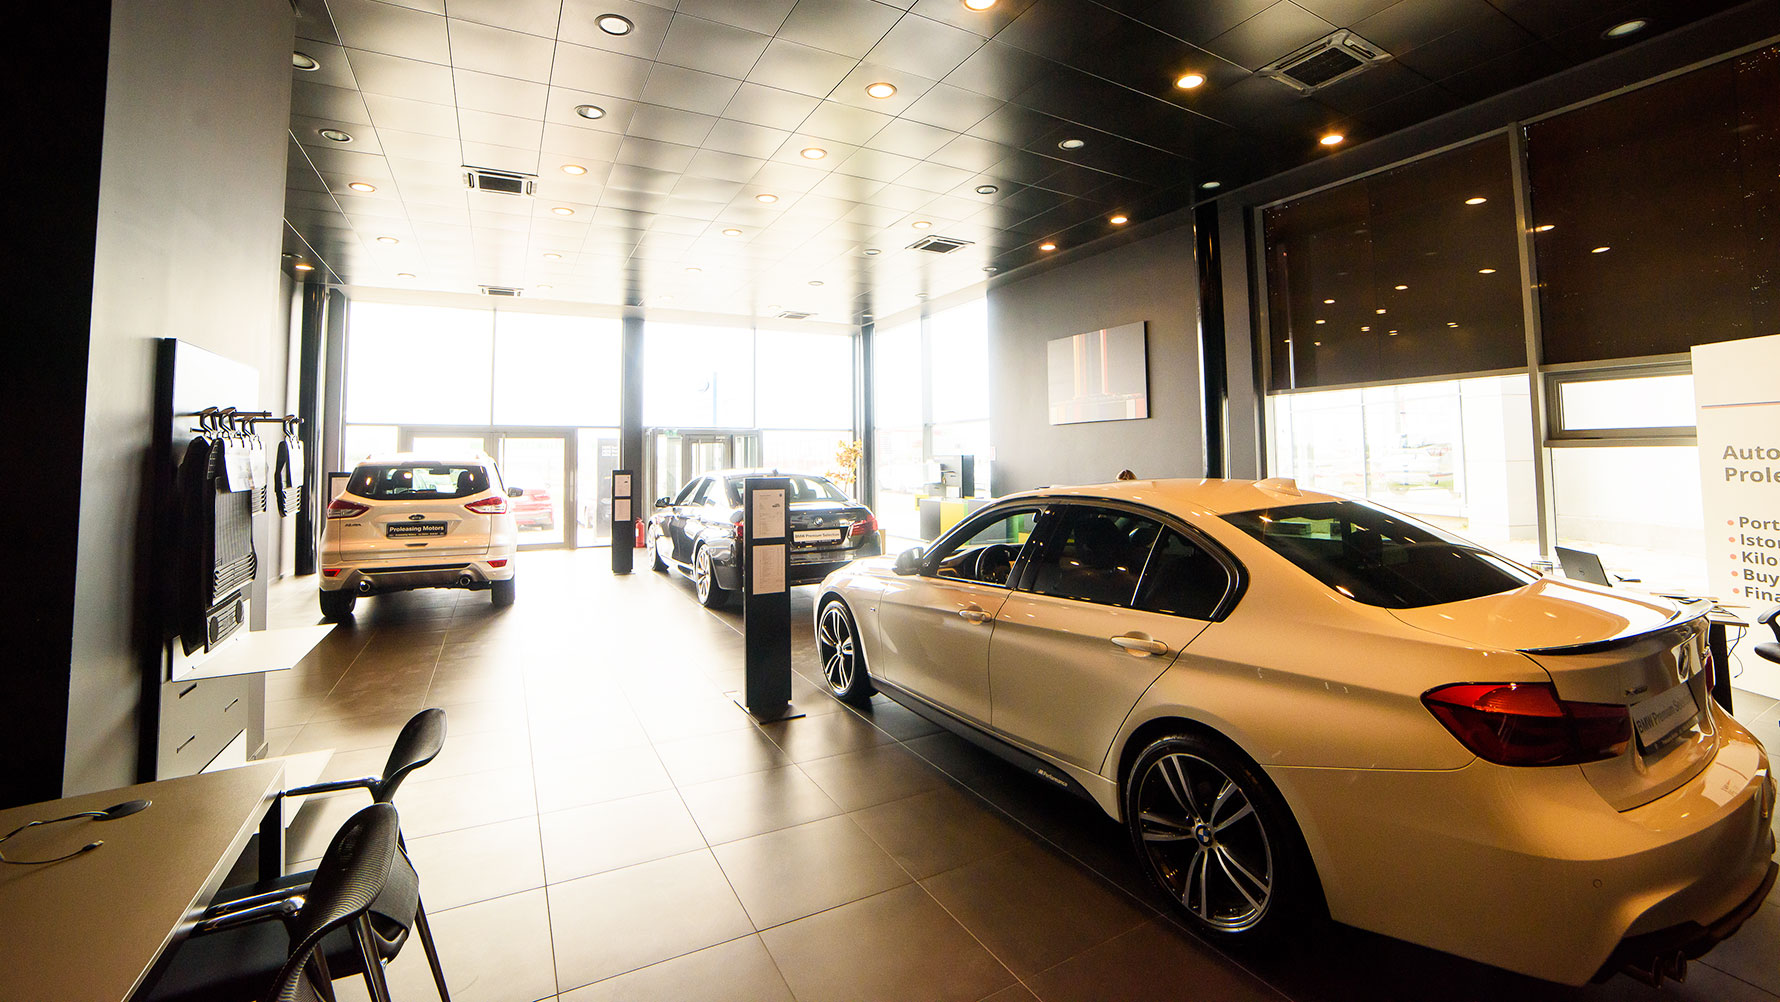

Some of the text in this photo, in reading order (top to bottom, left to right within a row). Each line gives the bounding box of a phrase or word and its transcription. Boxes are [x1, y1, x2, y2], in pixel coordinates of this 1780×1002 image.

[1723, 445, 1780, 460] Auto
[389, 525, 421, 533] Proleasing
[1739, 516, 1780, 531] Port
[1743, 568, 1780, 588] Buy
[1636, 714, 1654, 734] BMW
